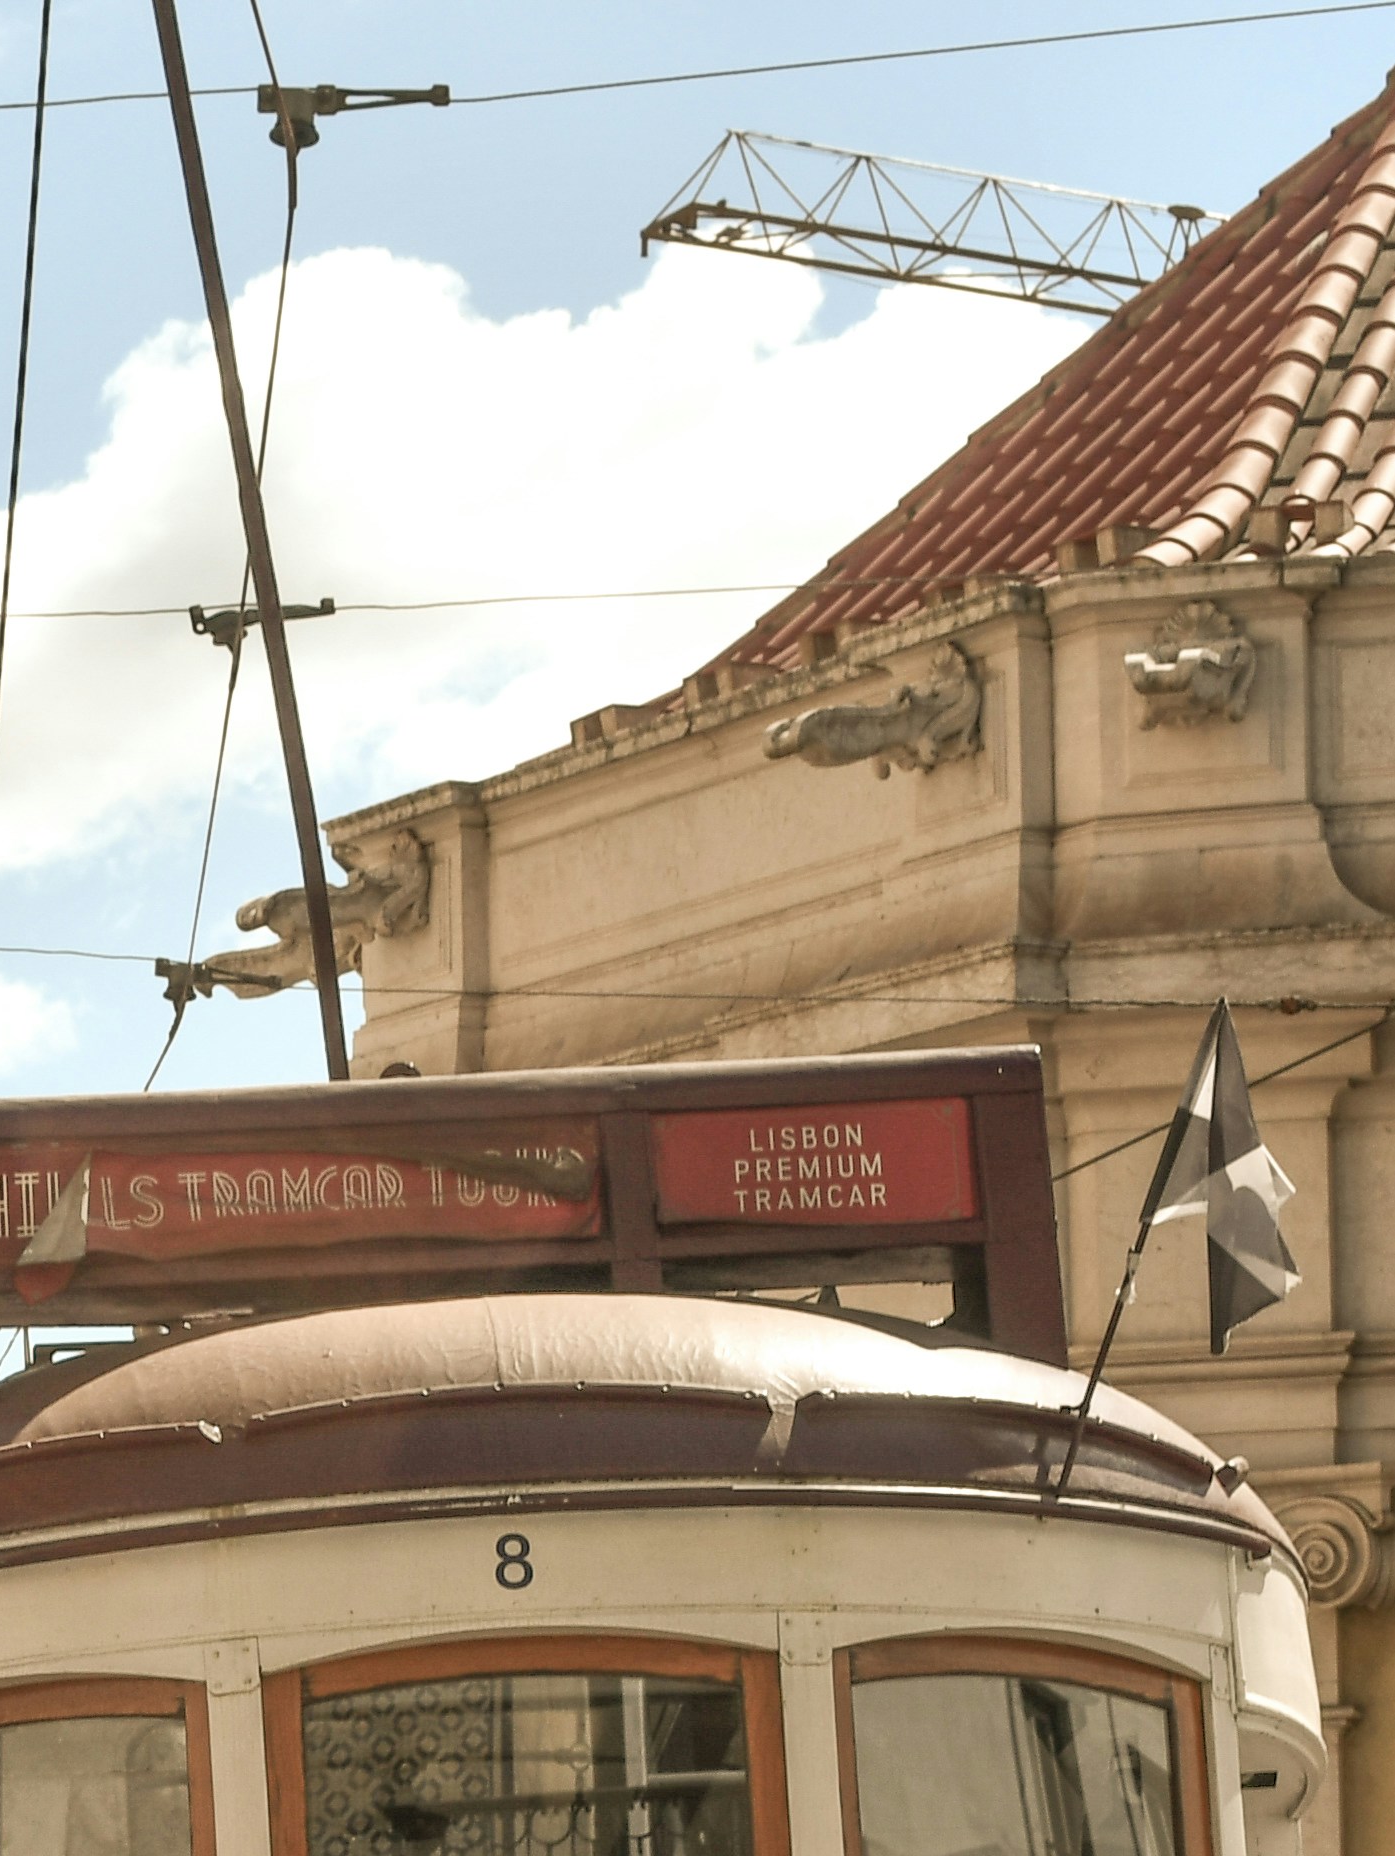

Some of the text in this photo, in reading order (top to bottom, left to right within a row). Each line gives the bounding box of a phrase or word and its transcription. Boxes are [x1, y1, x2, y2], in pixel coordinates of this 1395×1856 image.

[749, 1123, 863, 1152] LISBON
[734, 1153, 882, 1184] PREMIUM
[177, 1163, 407, 1222] TRAMCAR
[733, 1183, 887, 1214] TRAMCAR
[495, 1533, 534, 1590] 8
